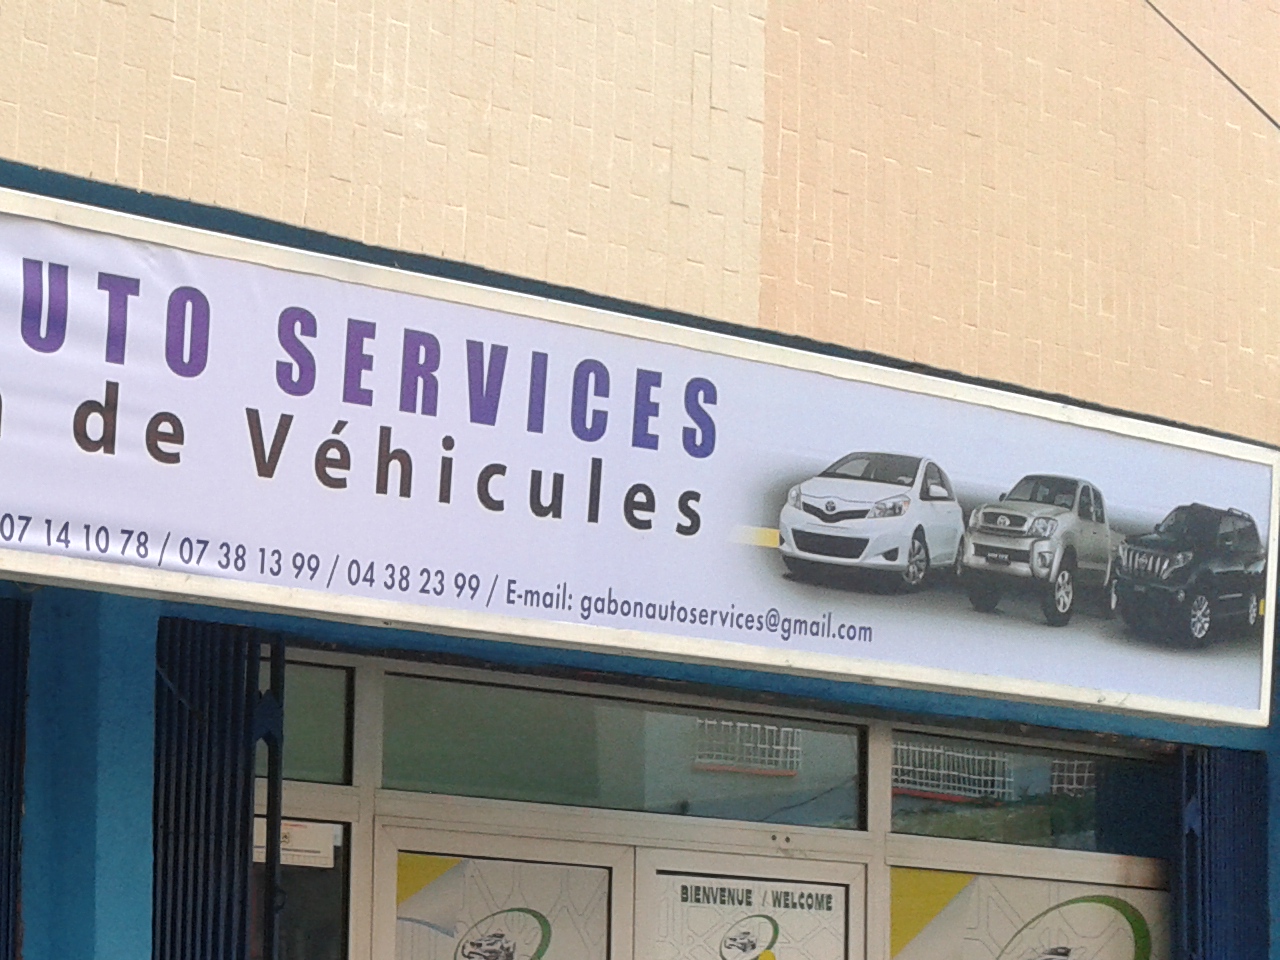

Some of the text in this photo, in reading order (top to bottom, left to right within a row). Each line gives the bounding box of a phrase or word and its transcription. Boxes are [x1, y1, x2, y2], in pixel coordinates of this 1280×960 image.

[276, 306, 718, 458] SERVICES
[73, 381, 184, 465] de
[245, 407, 701, 536] Véhicules
[0, 513, 33, 543] 07
[44, 518, 71, 549] 14
[83, 523, 110, 554] 10
[120, 529, 149, 558] 78
[179, 536, 210, 566] 07
[218, 541, 247, 573] 38
[258, 547, 282, 577] 13
[291, 551, 320, 582] 99
[347, 558, 375, 588] 04
[384, 563, 411, 592] 38
[419, 567, 445, 597] 23
[453, 572, 481, 601] 99
[506, 579, 573, 611] E-mail:
[580, 587, 873, 642] gabonautoservices@gmail.com
[680, 884, 753, 907] BIENVENUE
[771, 890, 833, 911] WELCOME
